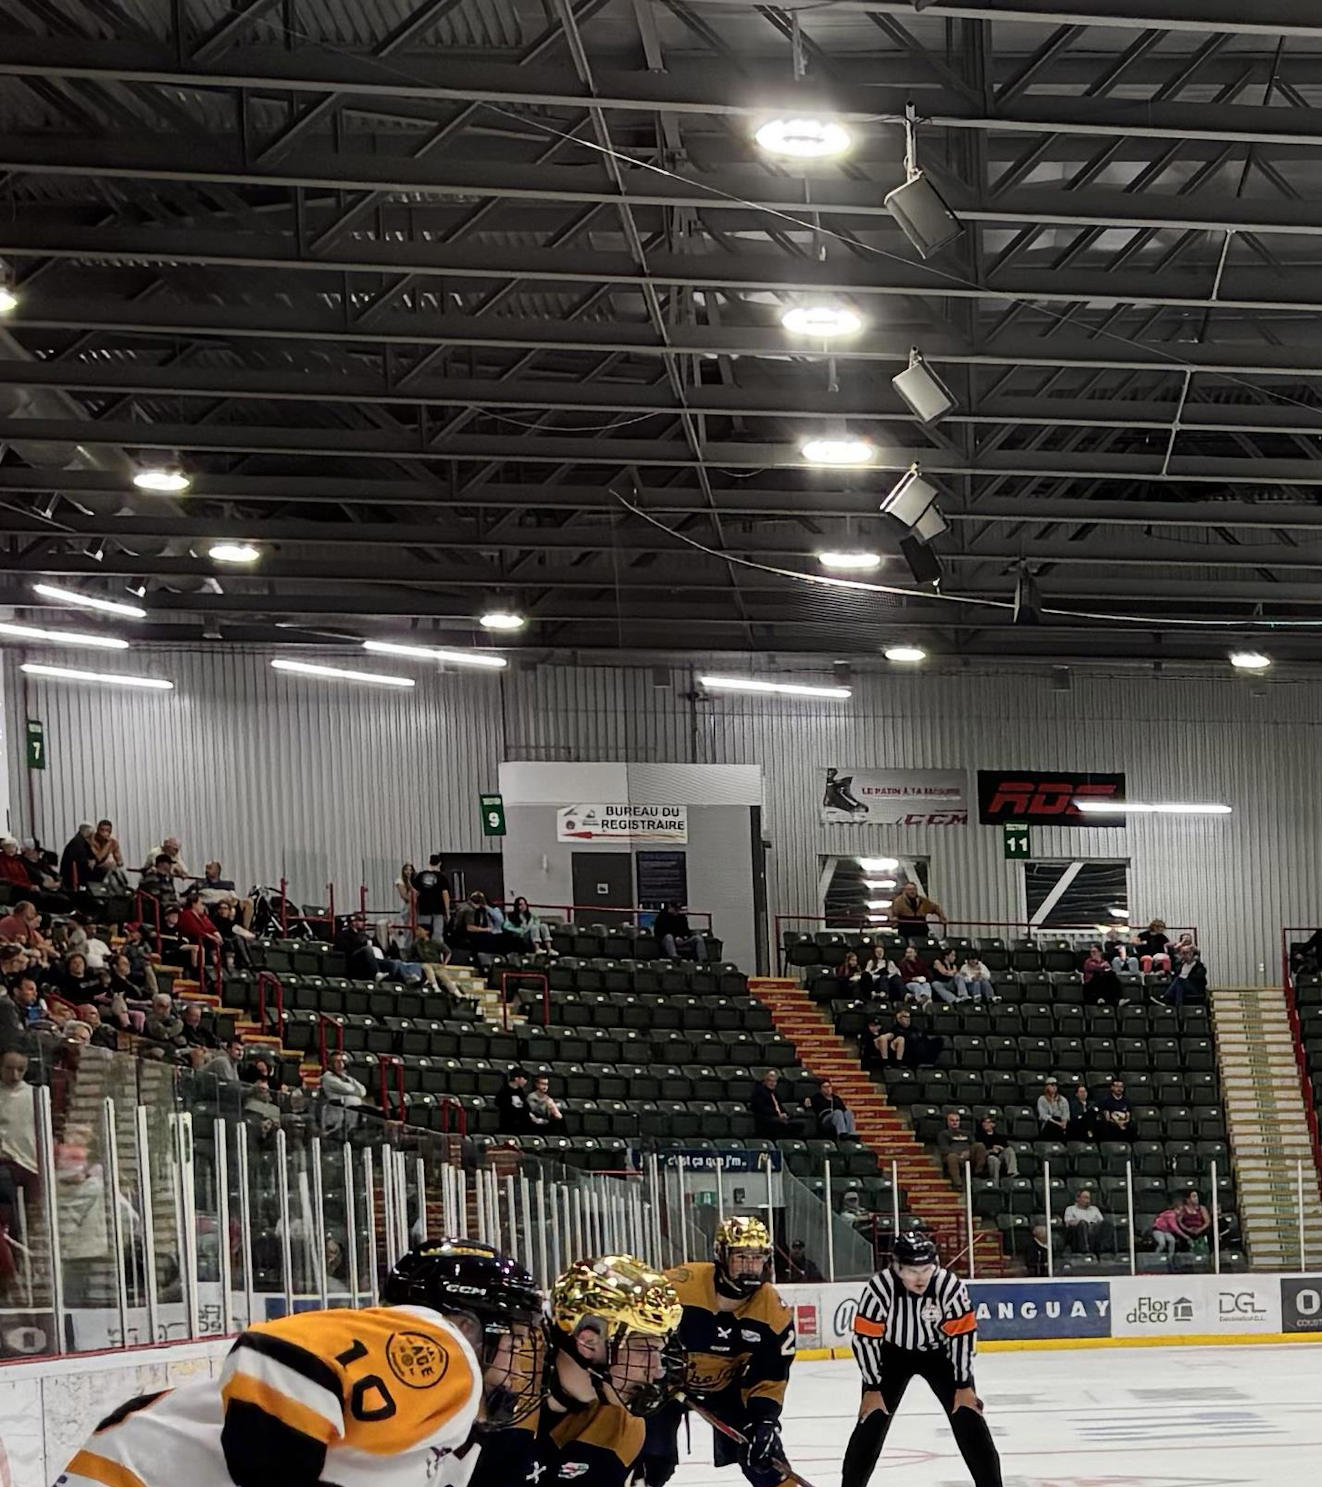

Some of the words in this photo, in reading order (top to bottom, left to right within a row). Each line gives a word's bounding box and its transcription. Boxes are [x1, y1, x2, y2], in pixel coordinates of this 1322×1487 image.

[32, 741, 41, 760] 7
[875, 788, 900, 796] PATIN
[606, 806, 658, 817] BUREAU
[662, 807, 680, 817] DU
[488, 812, 500, 828] 9
[601, 819, 685, 830] REGISTRAIRE
[904, 814, 968, 825] CCM
[1007, 837, 1028, 852] 11
[446, 1283, 487, 1296] CCM
[1138, 1296, 1170, 1312] Flor
[1219, 1291, 1267, 1313] DGL
[977, 1299, 1111, 1321] ANGUAY
[1126, 1307, 1168, 1324] deco
